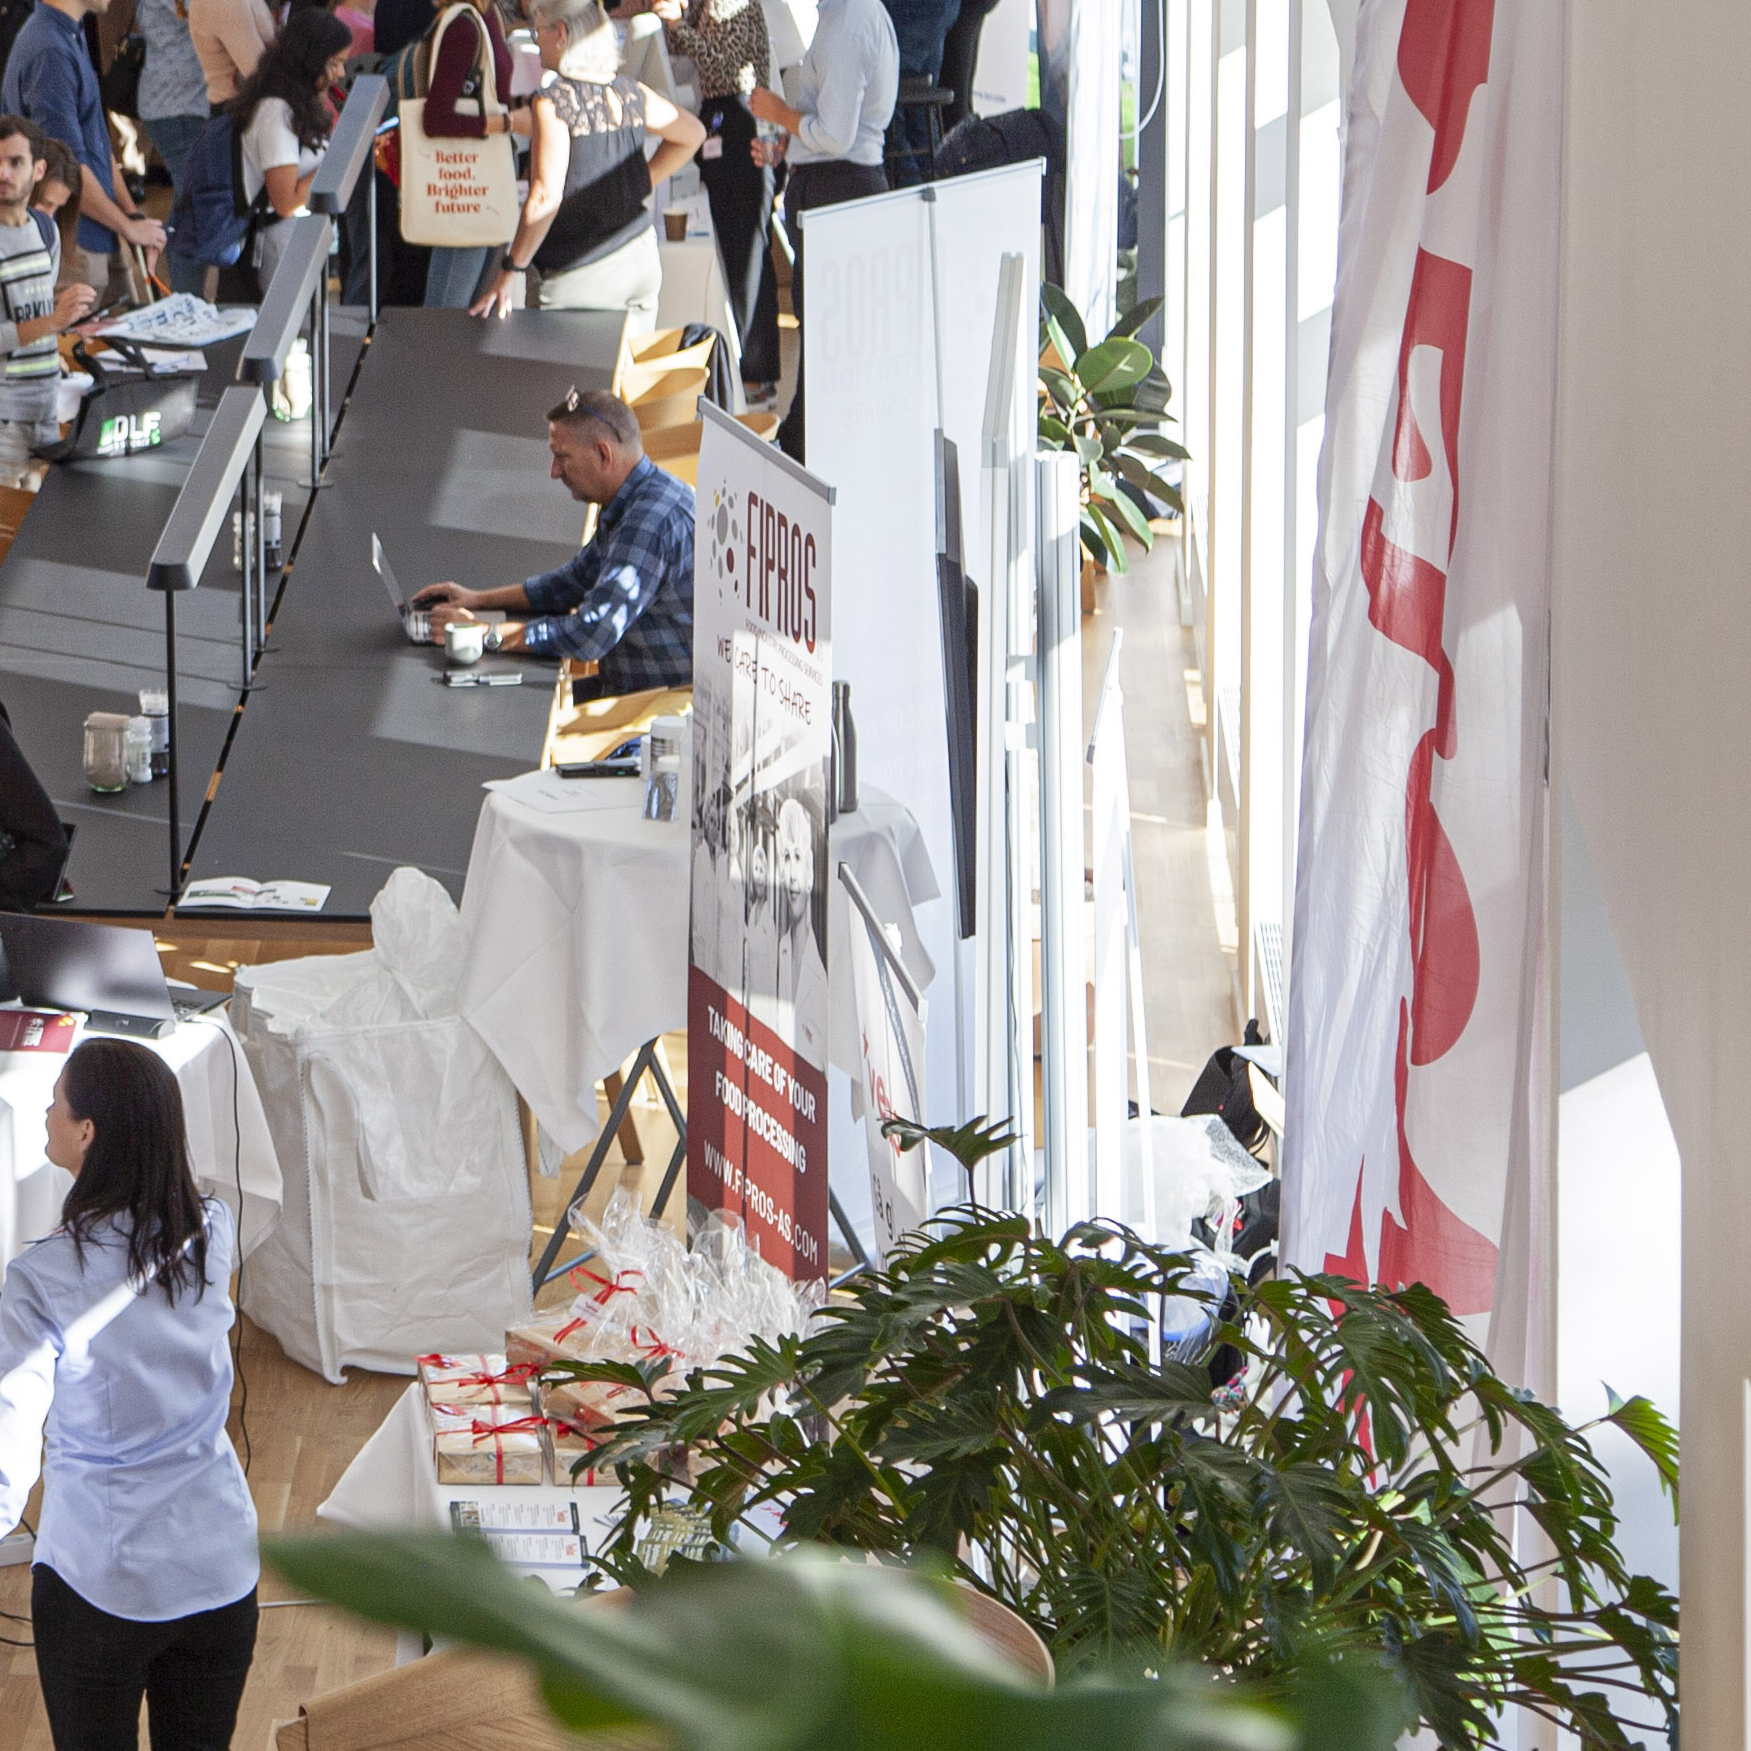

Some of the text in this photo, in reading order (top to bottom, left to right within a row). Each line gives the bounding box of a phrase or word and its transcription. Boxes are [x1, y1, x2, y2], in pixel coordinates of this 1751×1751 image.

[435, 150, 479, 164] Better
[439, 167, 476, 180] food.
[427, 182, 490, 200] Brighter
[435, 200, 480, 213] future
[113, 411, 161, 442] DLF
[746, 490, 817, 655] FIPROS
[717, 634, 811, 726] WE CARE TO SHARE
[708, 1005, 744, 1060] TAKING
[744, 1038, 773, 1086] CARE
[773, 1062, 787, 1096] OF
[787, 1074, 816, 1125] YOUR
[715, 1070, 807, 1174] FOOD PROCESSING
[703, 1139, 818, 1266] WWW.FIPROS-AS.COM
